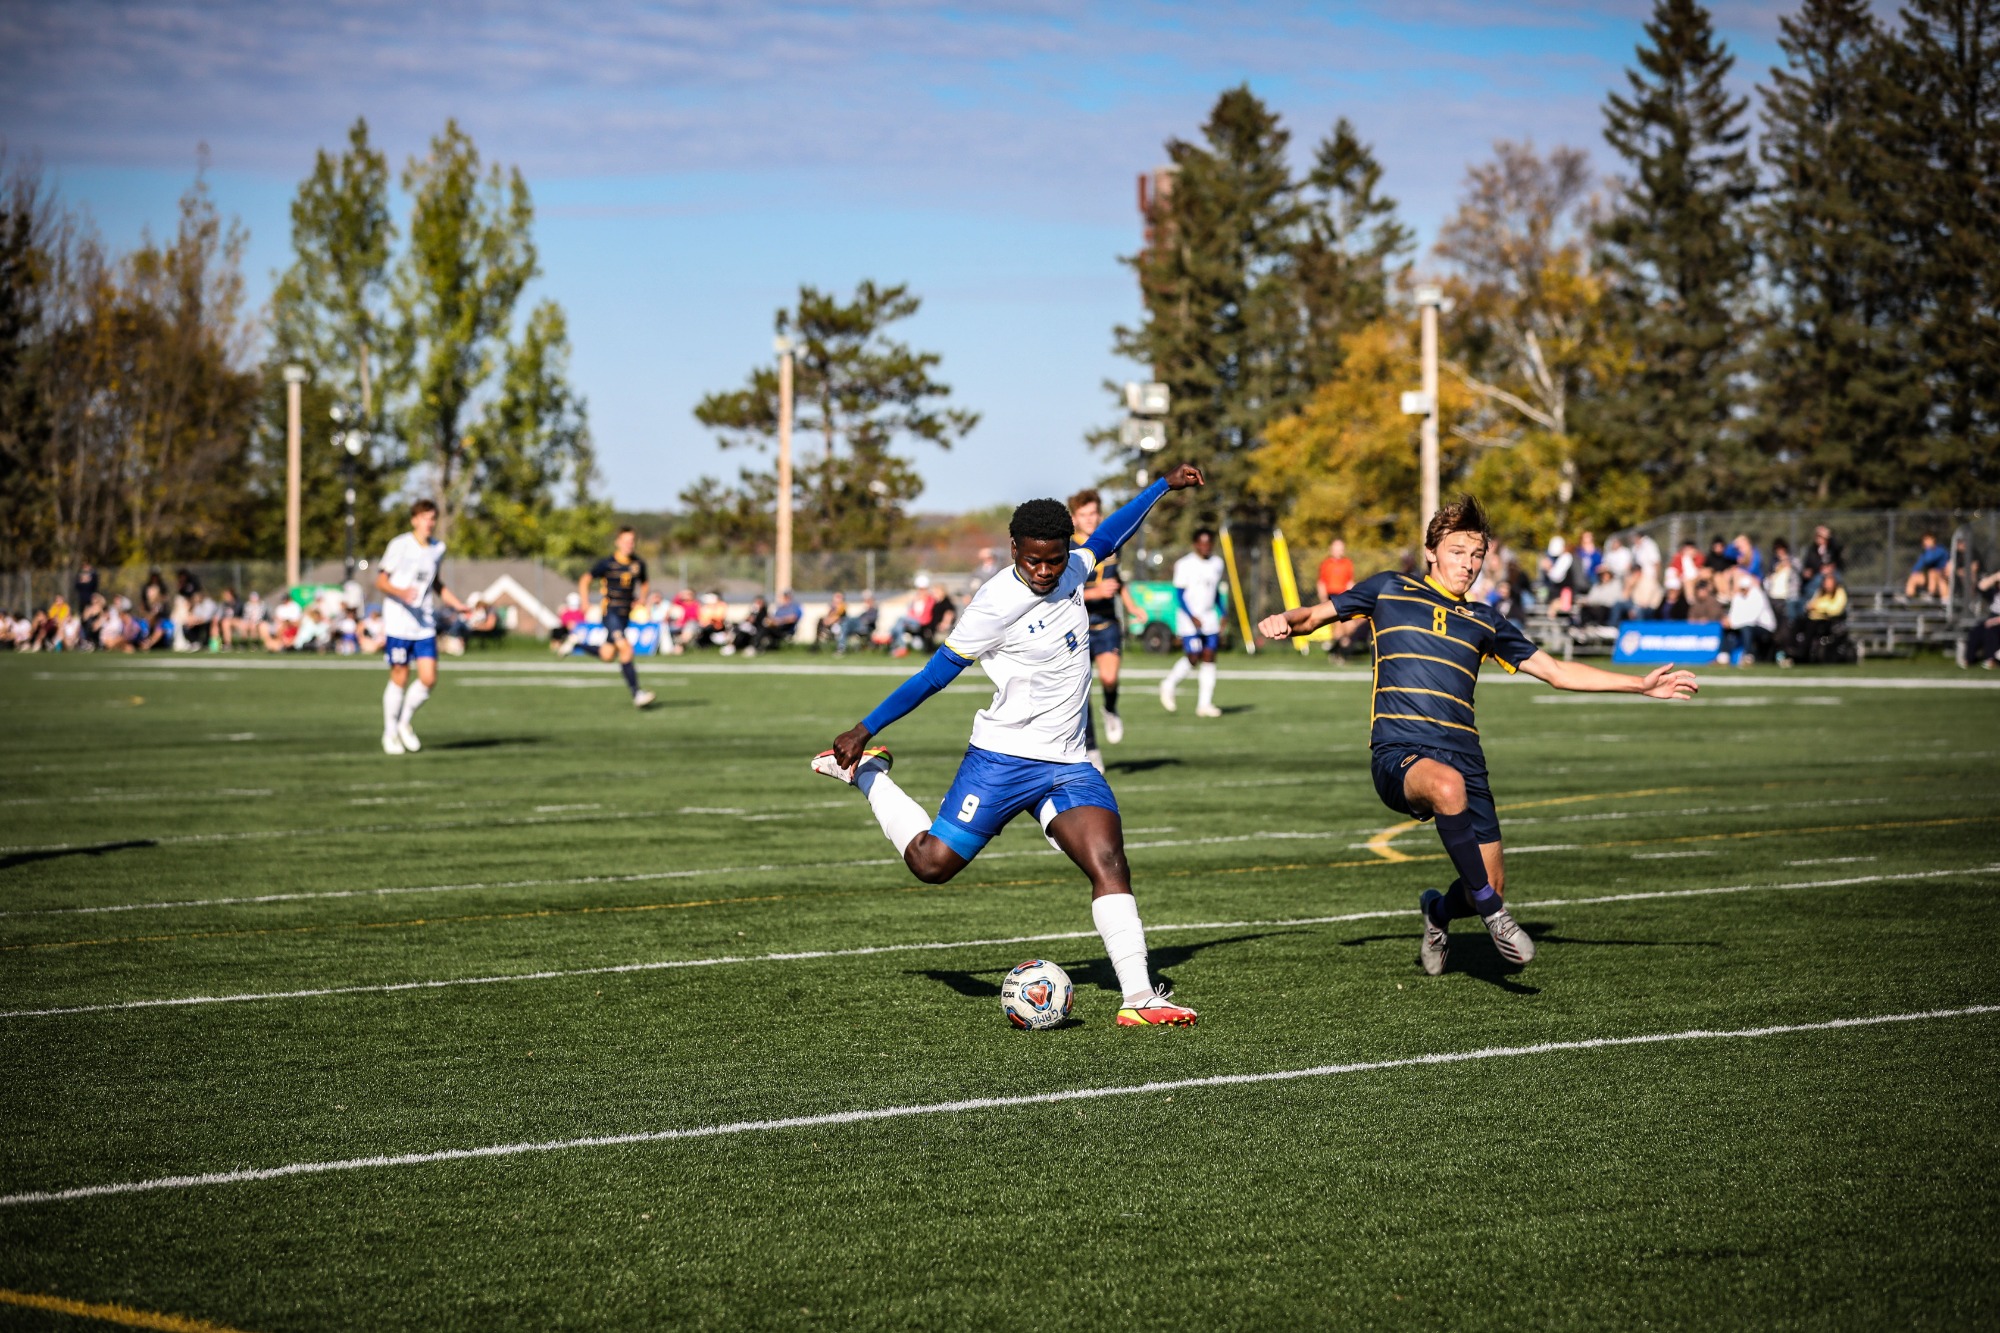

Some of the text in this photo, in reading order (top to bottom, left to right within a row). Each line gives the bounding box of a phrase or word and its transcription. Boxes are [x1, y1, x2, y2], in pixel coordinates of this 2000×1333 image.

[1432, 606, 1447, 635] 8
[957, 794, 980, 823] 9
[1032, 1009, 1058, 1024] GAME
